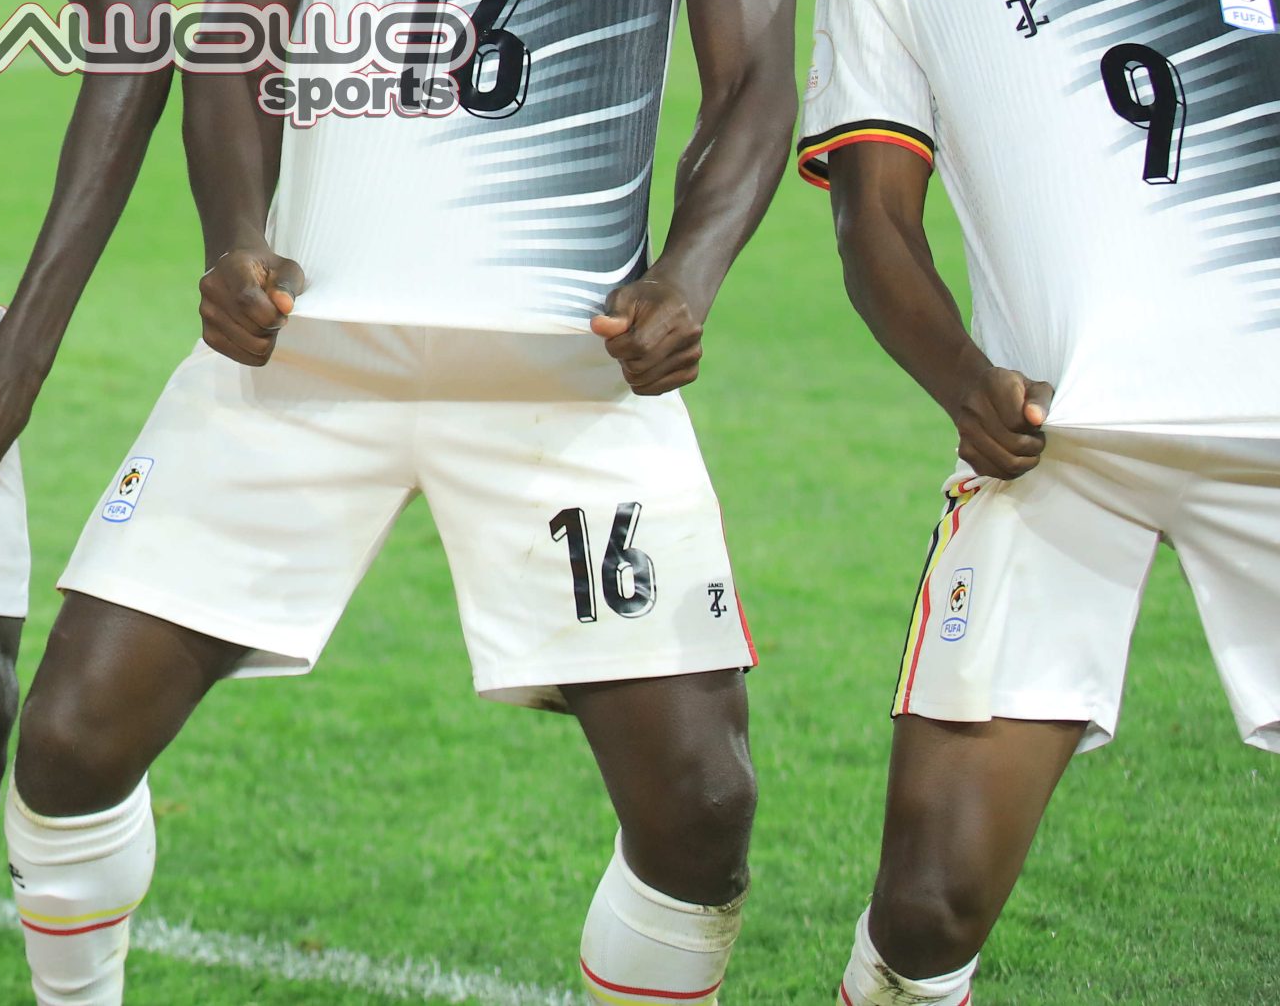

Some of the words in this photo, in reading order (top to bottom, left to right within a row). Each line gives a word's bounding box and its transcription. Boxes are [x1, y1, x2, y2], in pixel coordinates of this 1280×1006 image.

[1232, 10, 1266, 26] FUFA
[1100, 42, 1187, 185] 9
[549, 501, 657, 624] 16
